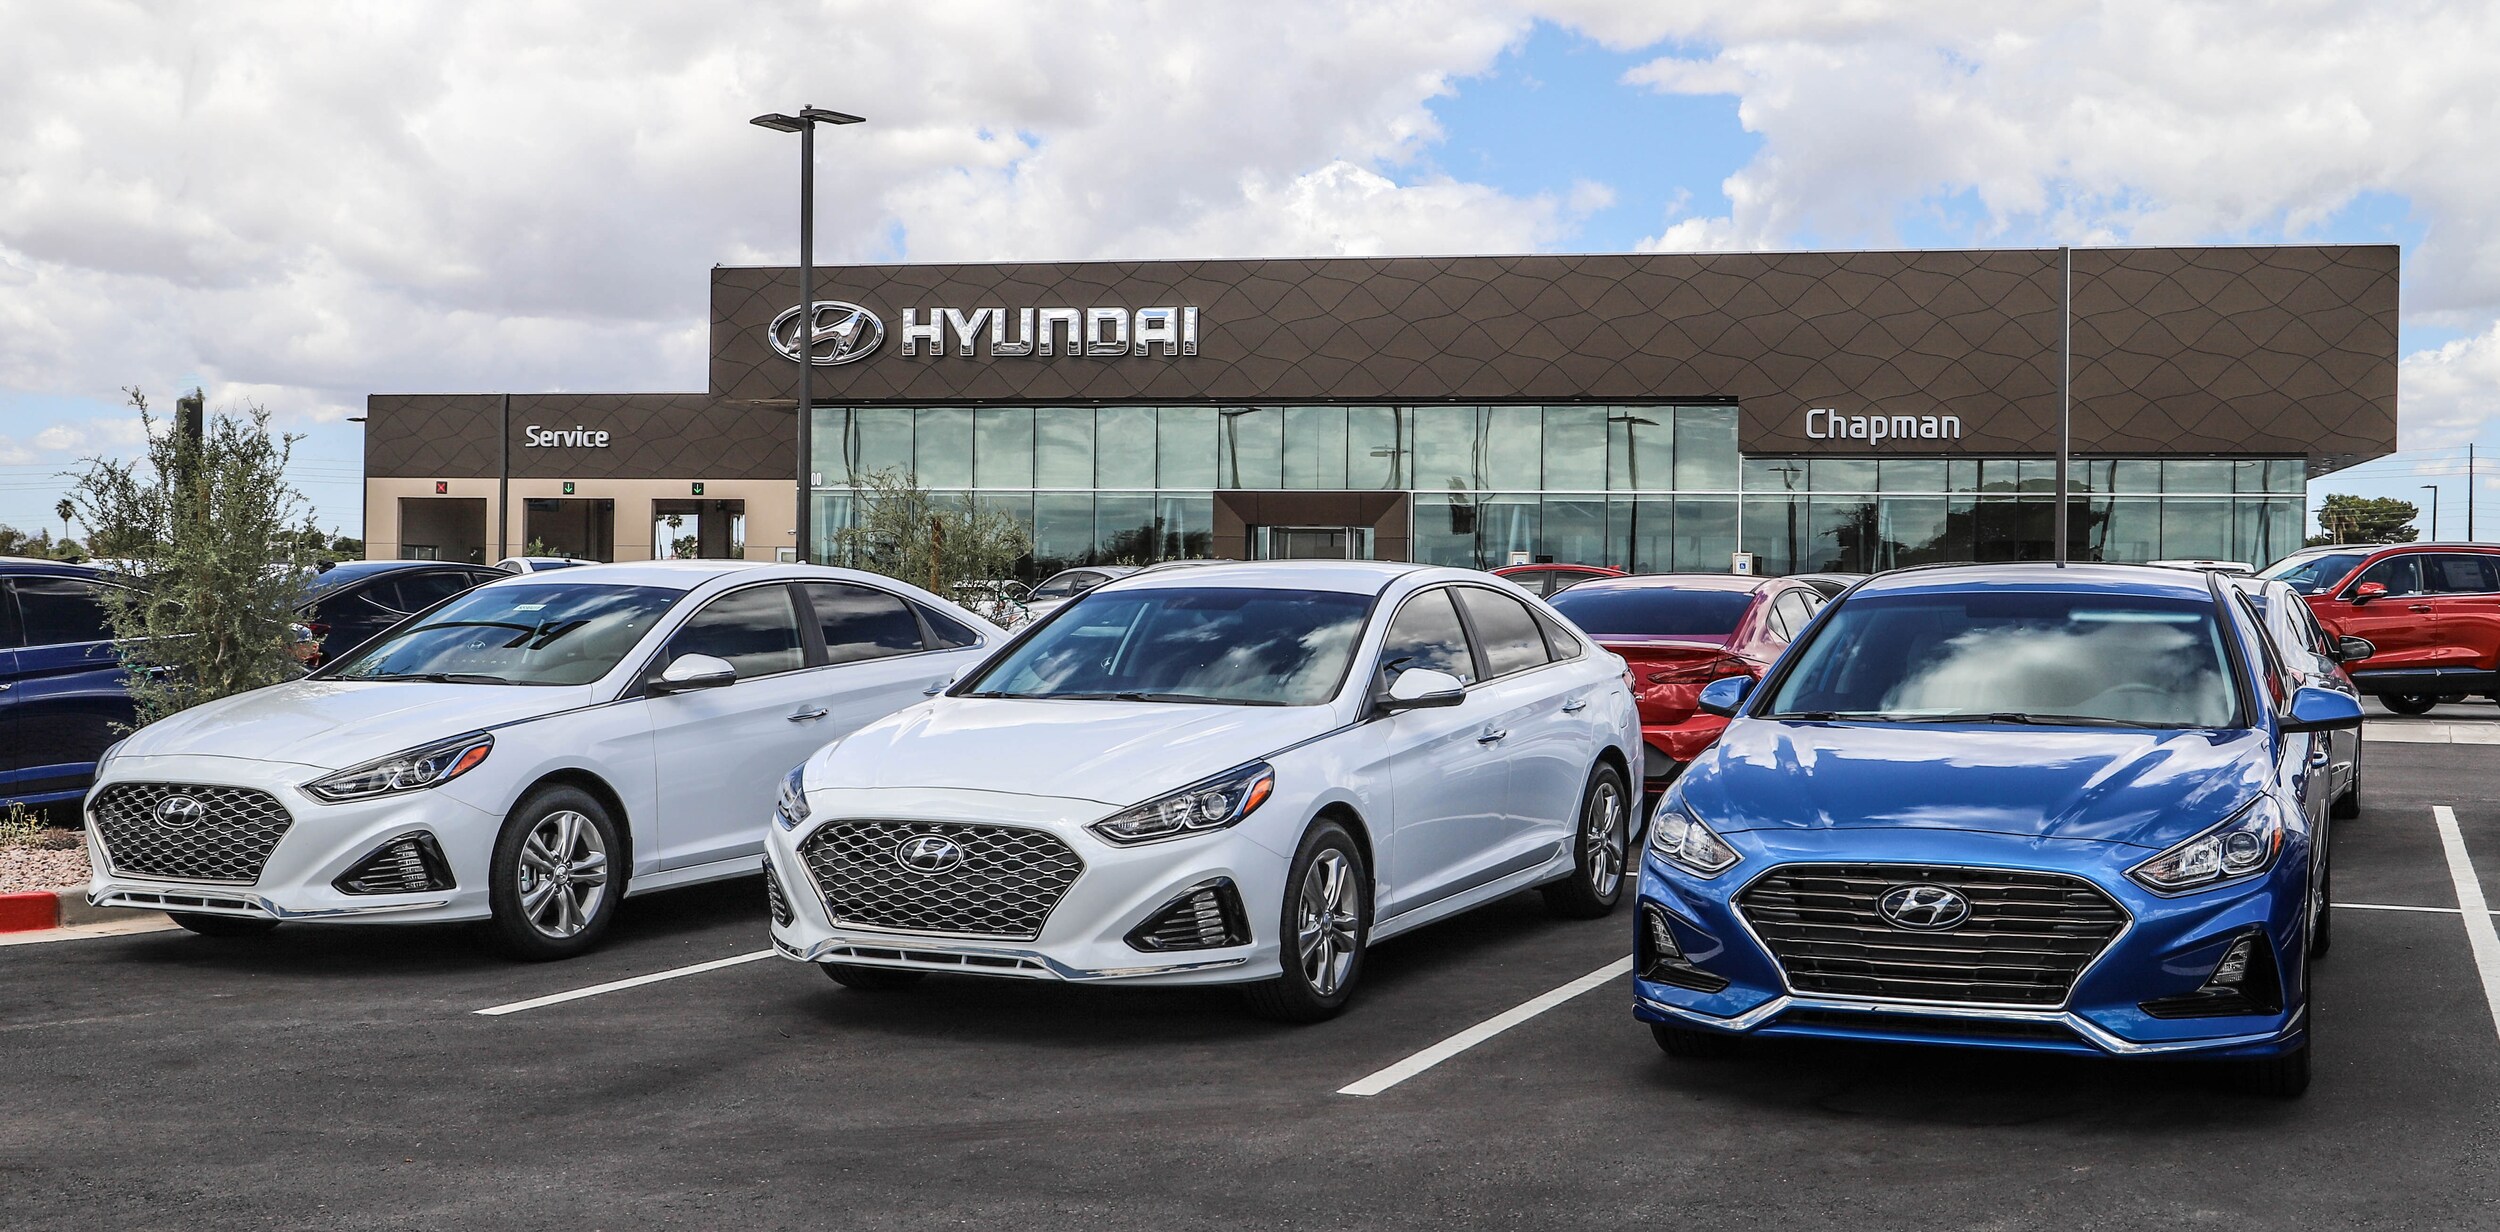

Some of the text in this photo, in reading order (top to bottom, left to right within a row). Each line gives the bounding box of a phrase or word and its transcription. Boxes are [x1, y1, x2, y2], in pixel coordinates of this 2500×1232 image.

[902, 307, 1198, 357] HYUNDAI
[525, 425, 610, 447] Service
[1805, 408, 1961, 446] Chapman
